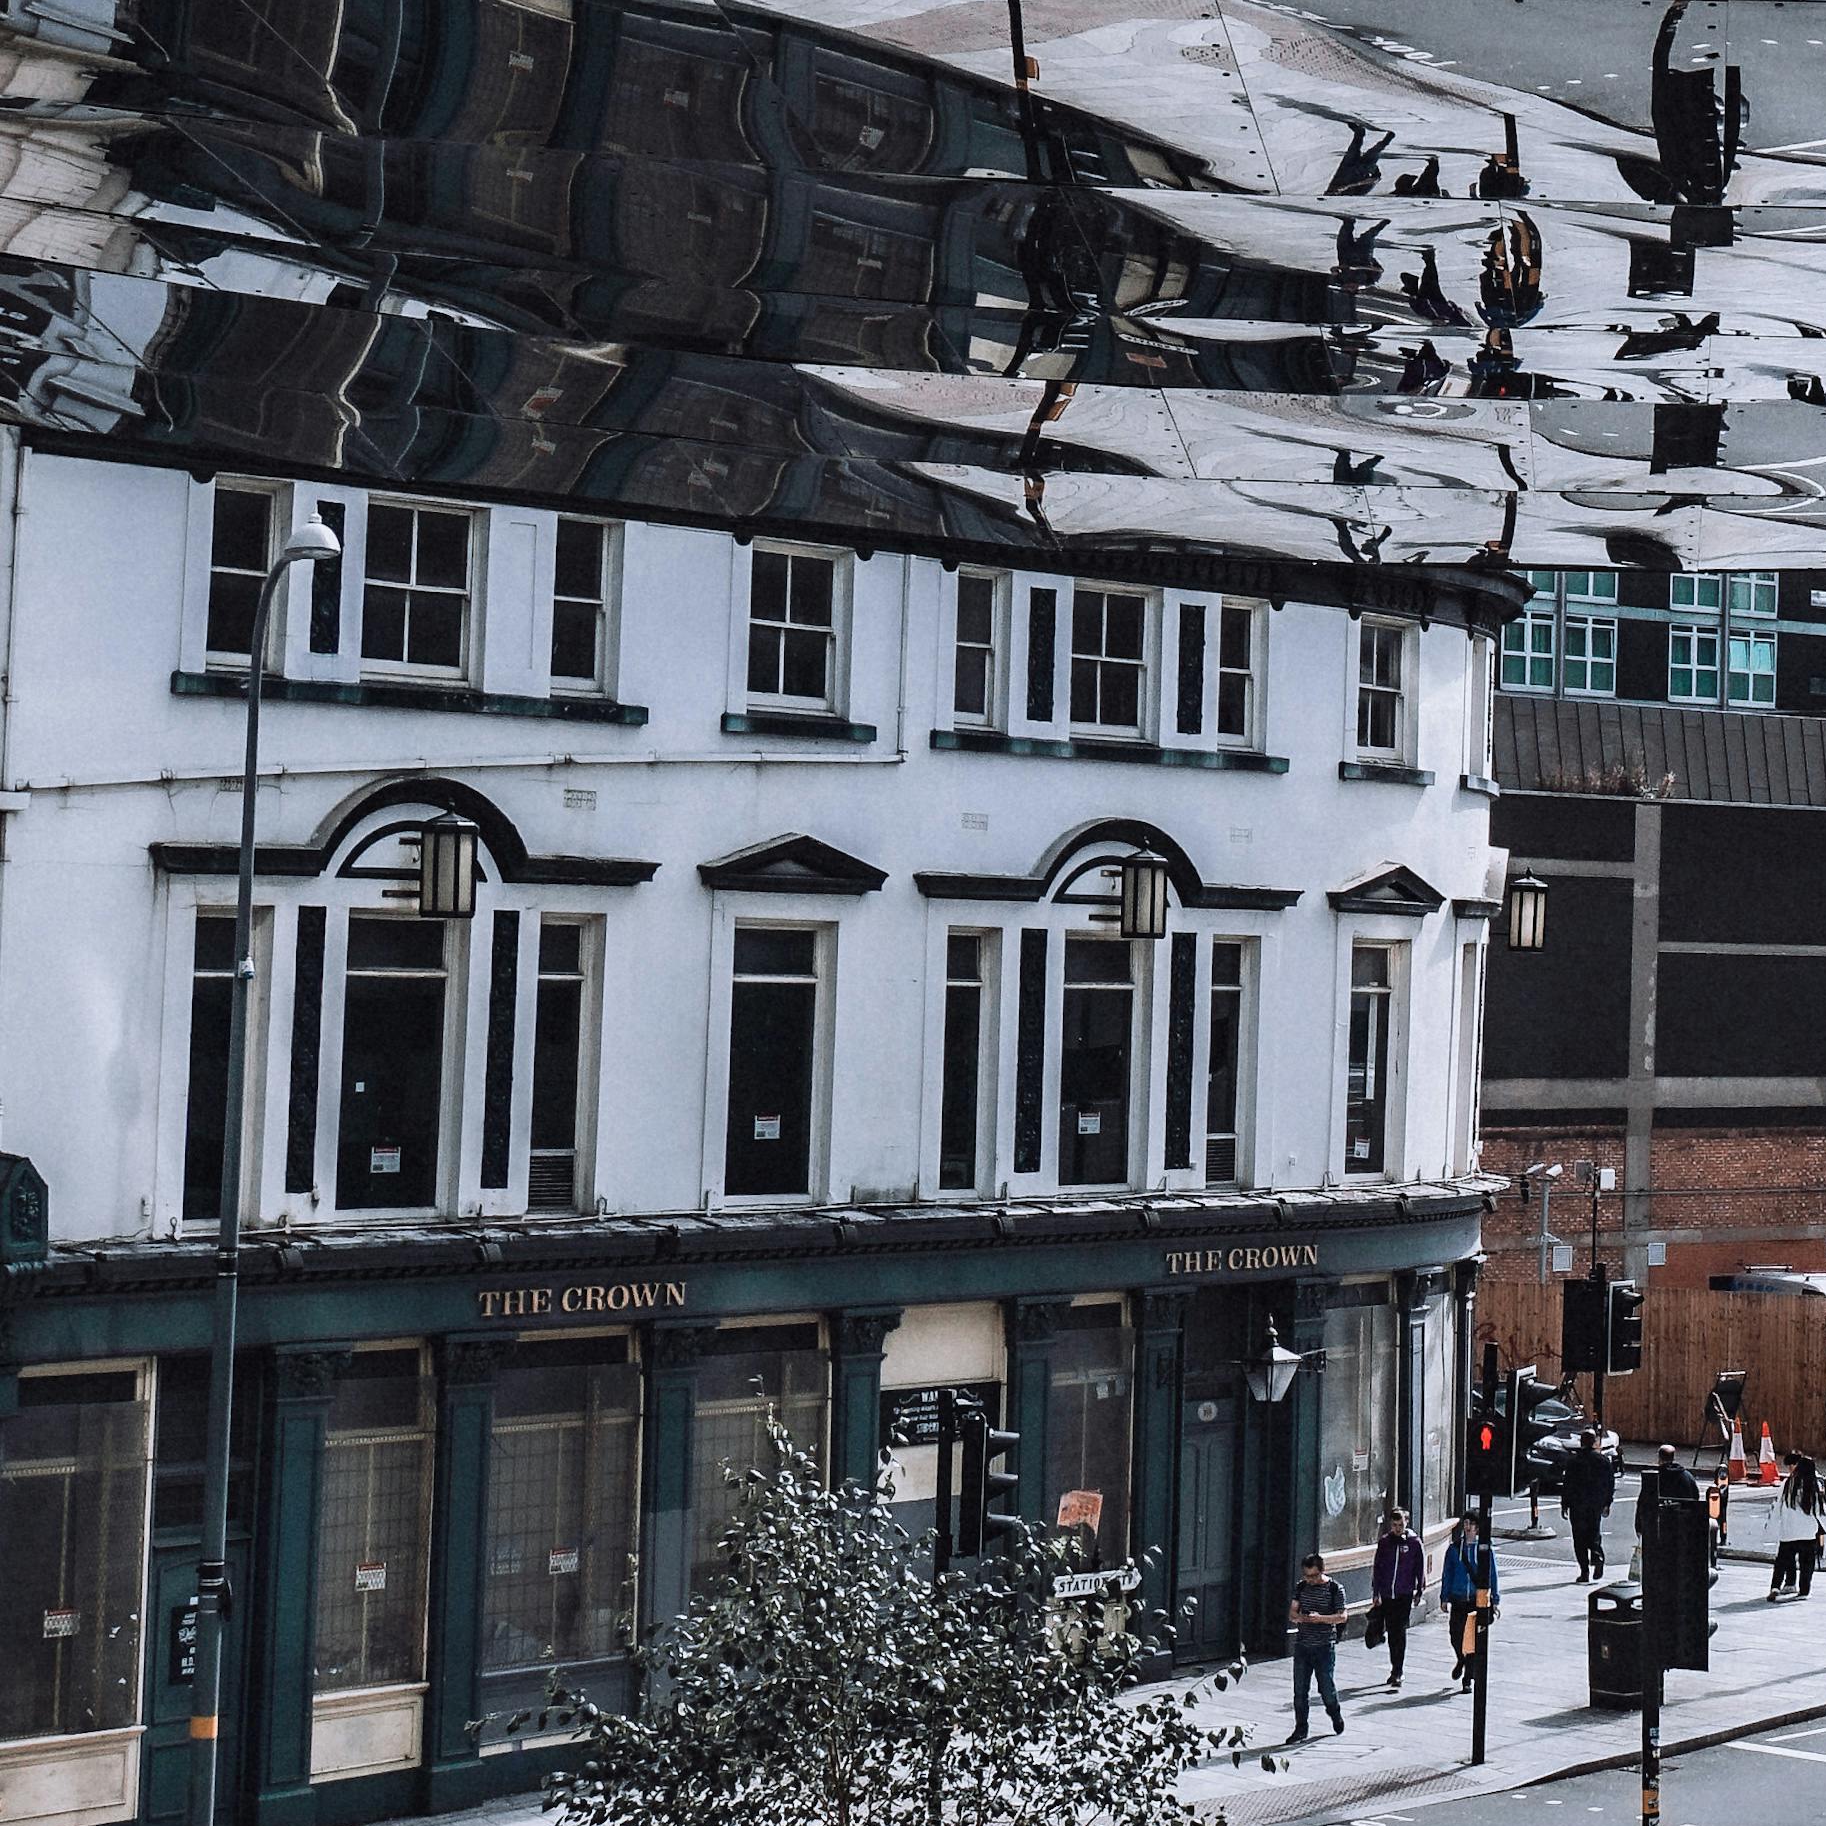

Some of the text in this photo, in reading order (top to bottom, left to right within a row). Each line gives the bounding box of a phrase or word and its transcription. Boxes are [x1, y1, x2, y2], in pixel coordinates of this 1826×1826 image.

[1166, 1244, 1319, 1274] THE CROWN
[479, 1281, 687, 1317] THE CROWN
[1059, 1577, 1102, 1593] STATIO
